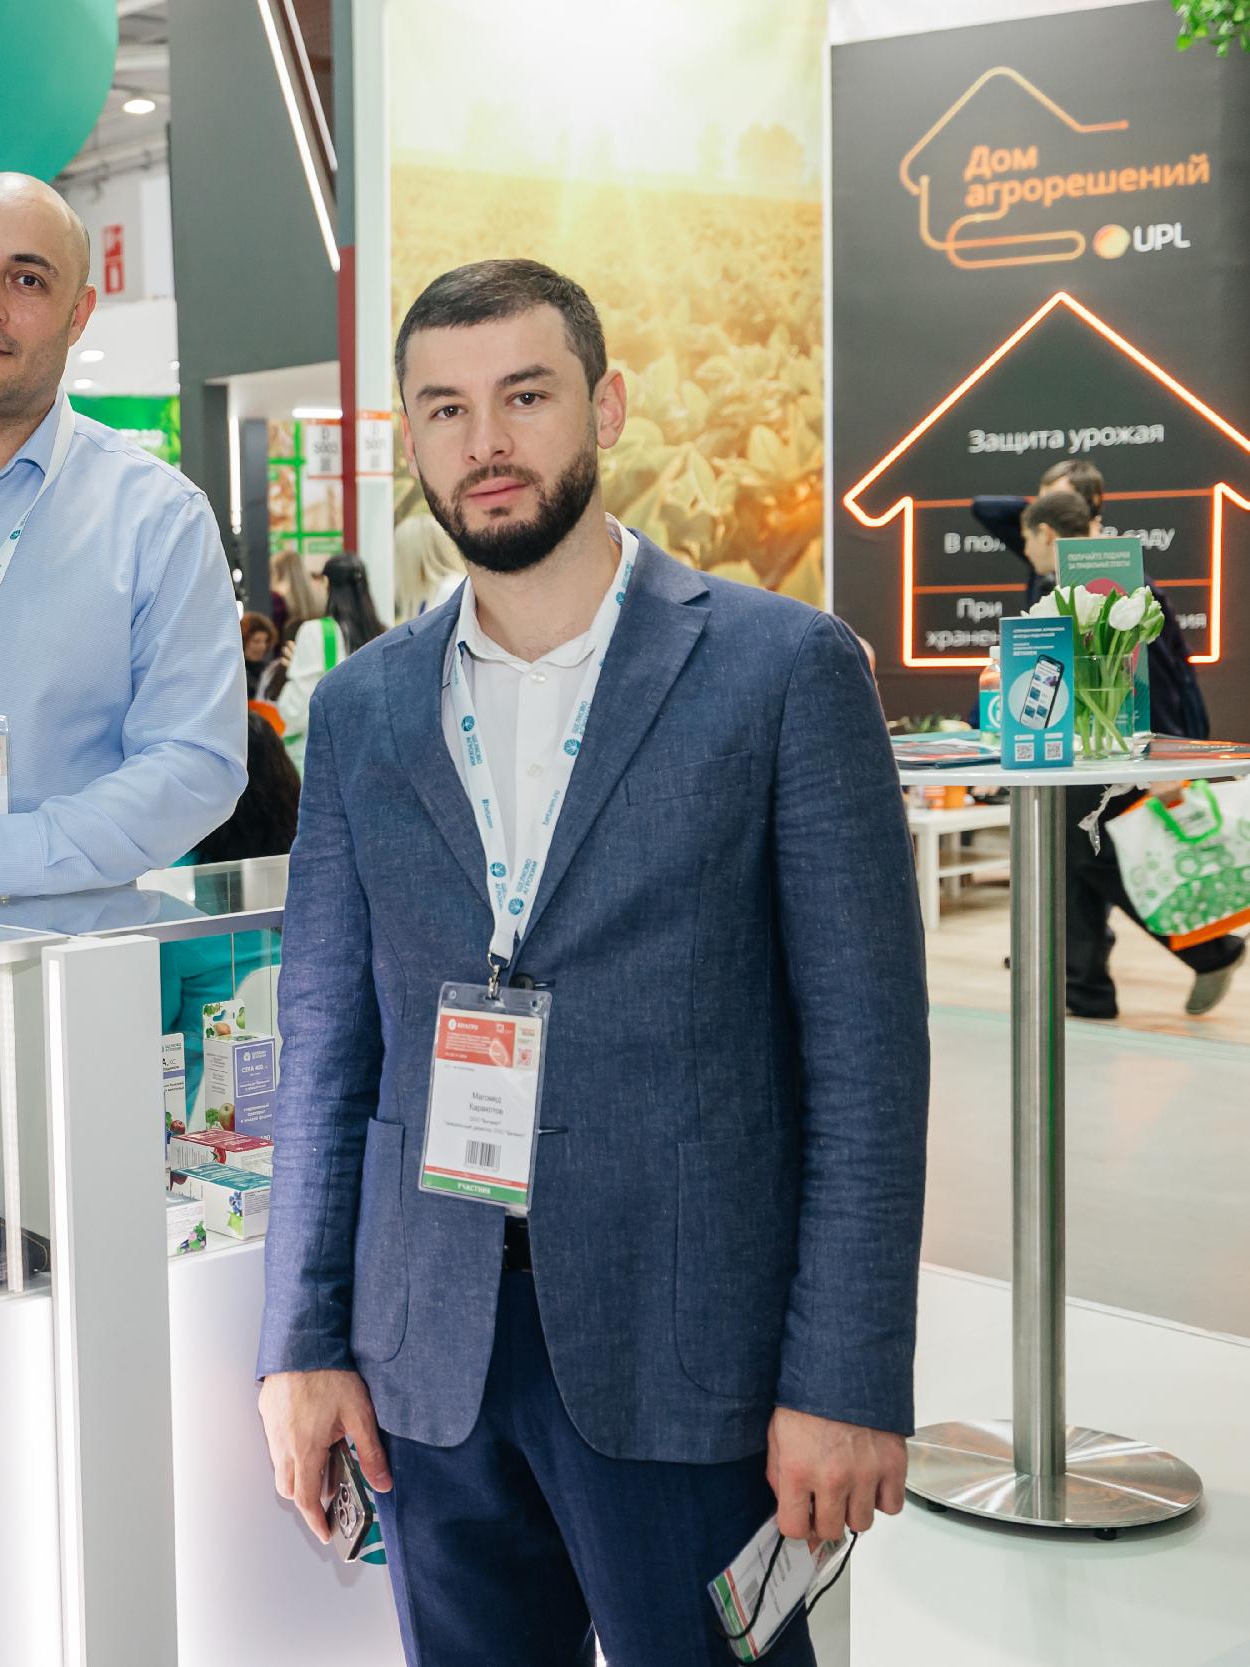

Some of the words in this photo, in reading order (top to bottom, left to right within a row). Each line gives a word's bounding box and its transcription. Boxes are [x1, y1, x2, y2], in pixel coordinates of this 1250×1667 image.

[963, 144, 1039, 182] Дом
[963, 152, 1211, 209] агрорешений
[1132, 221, 1192, 253] UPL
[967, 428, 1066, 455] Защита
[1067, 423, 1165, 454] урожая
[944, 532, 961, 553] В
[956, 597, 1003, 621] При
[925, 629, 1000, 651] хранен
